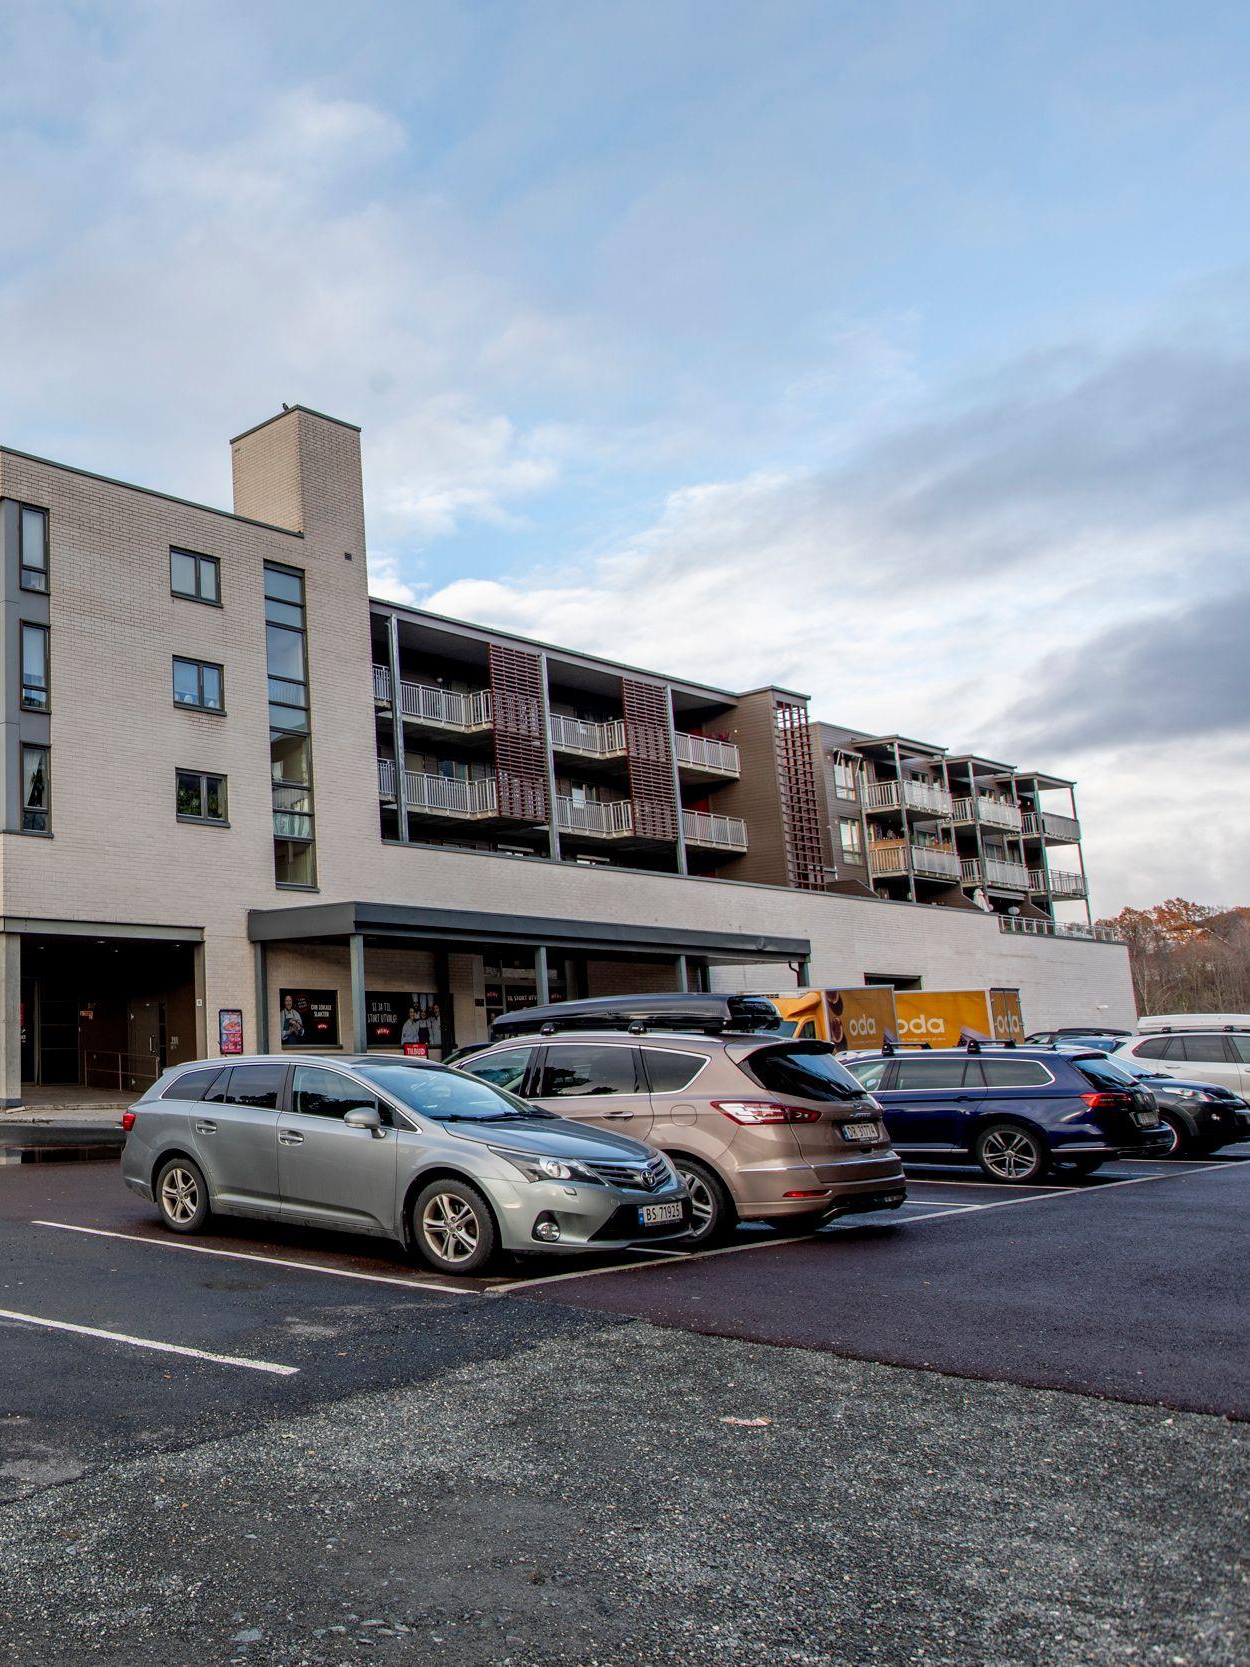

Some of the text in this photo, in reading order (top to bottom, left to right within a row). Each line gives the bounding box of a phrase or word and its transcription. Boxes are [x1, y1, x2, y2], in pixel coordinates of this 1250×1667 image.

[850, 1014, 876, 1036] oda
[897, 1014, 945, 1034] oda
[646, 1204, 680, 1221] BS 71925
